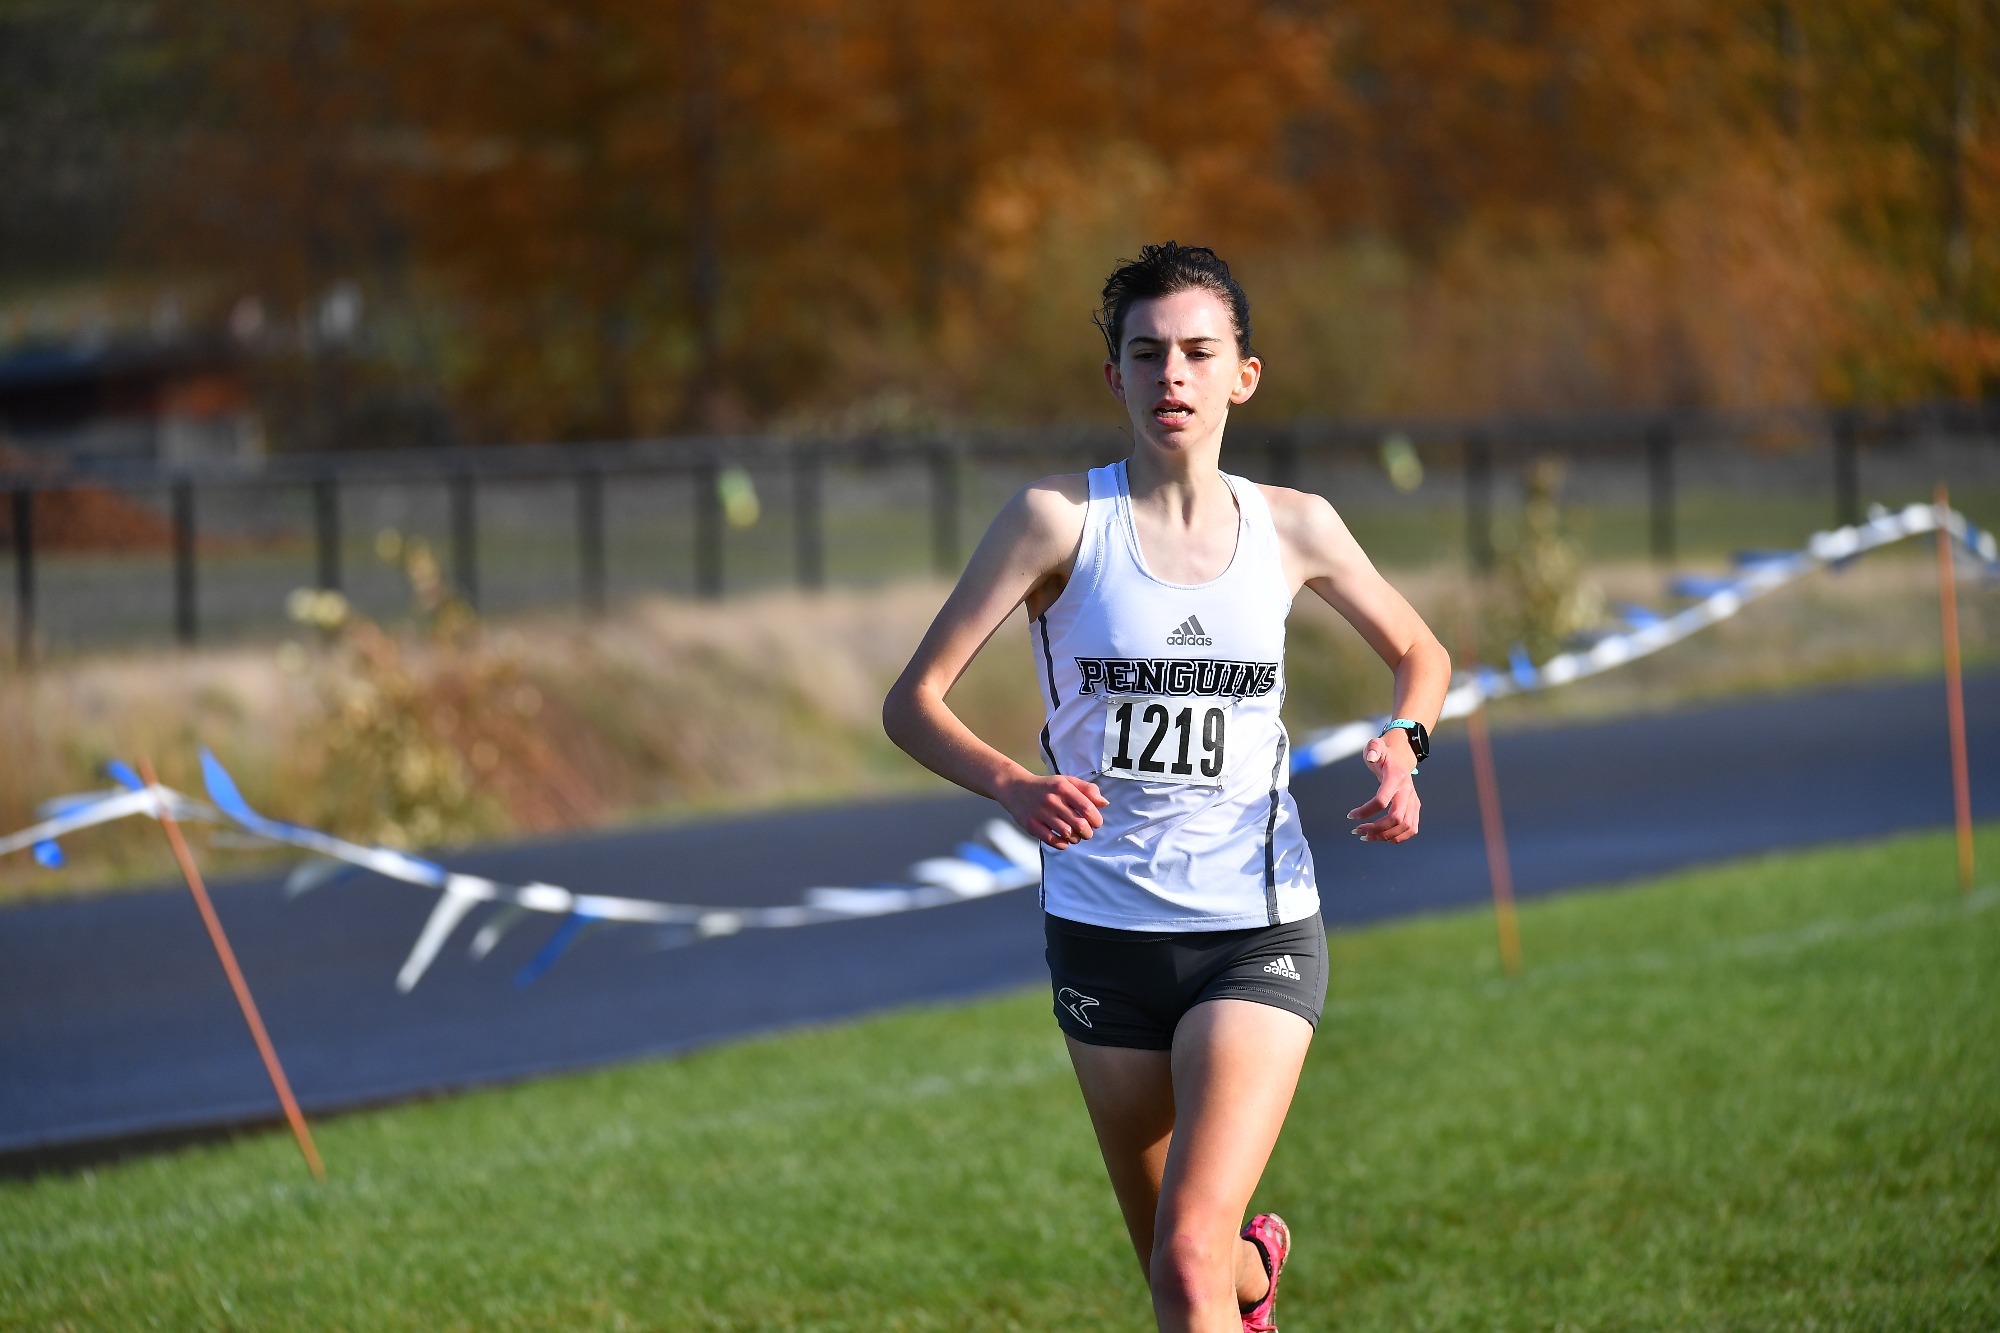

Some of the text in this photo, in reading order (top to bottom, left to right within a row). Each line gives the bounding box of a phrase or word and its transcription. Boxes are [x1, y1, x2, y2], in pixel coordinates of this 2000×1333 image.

[1167, 634, 1212, 646] adidas
[1074, 657, 1278, 697] PENGUINS
[1112, 703, 1225, 777] 1219
[1264, 965, 1300, 980] adidas
